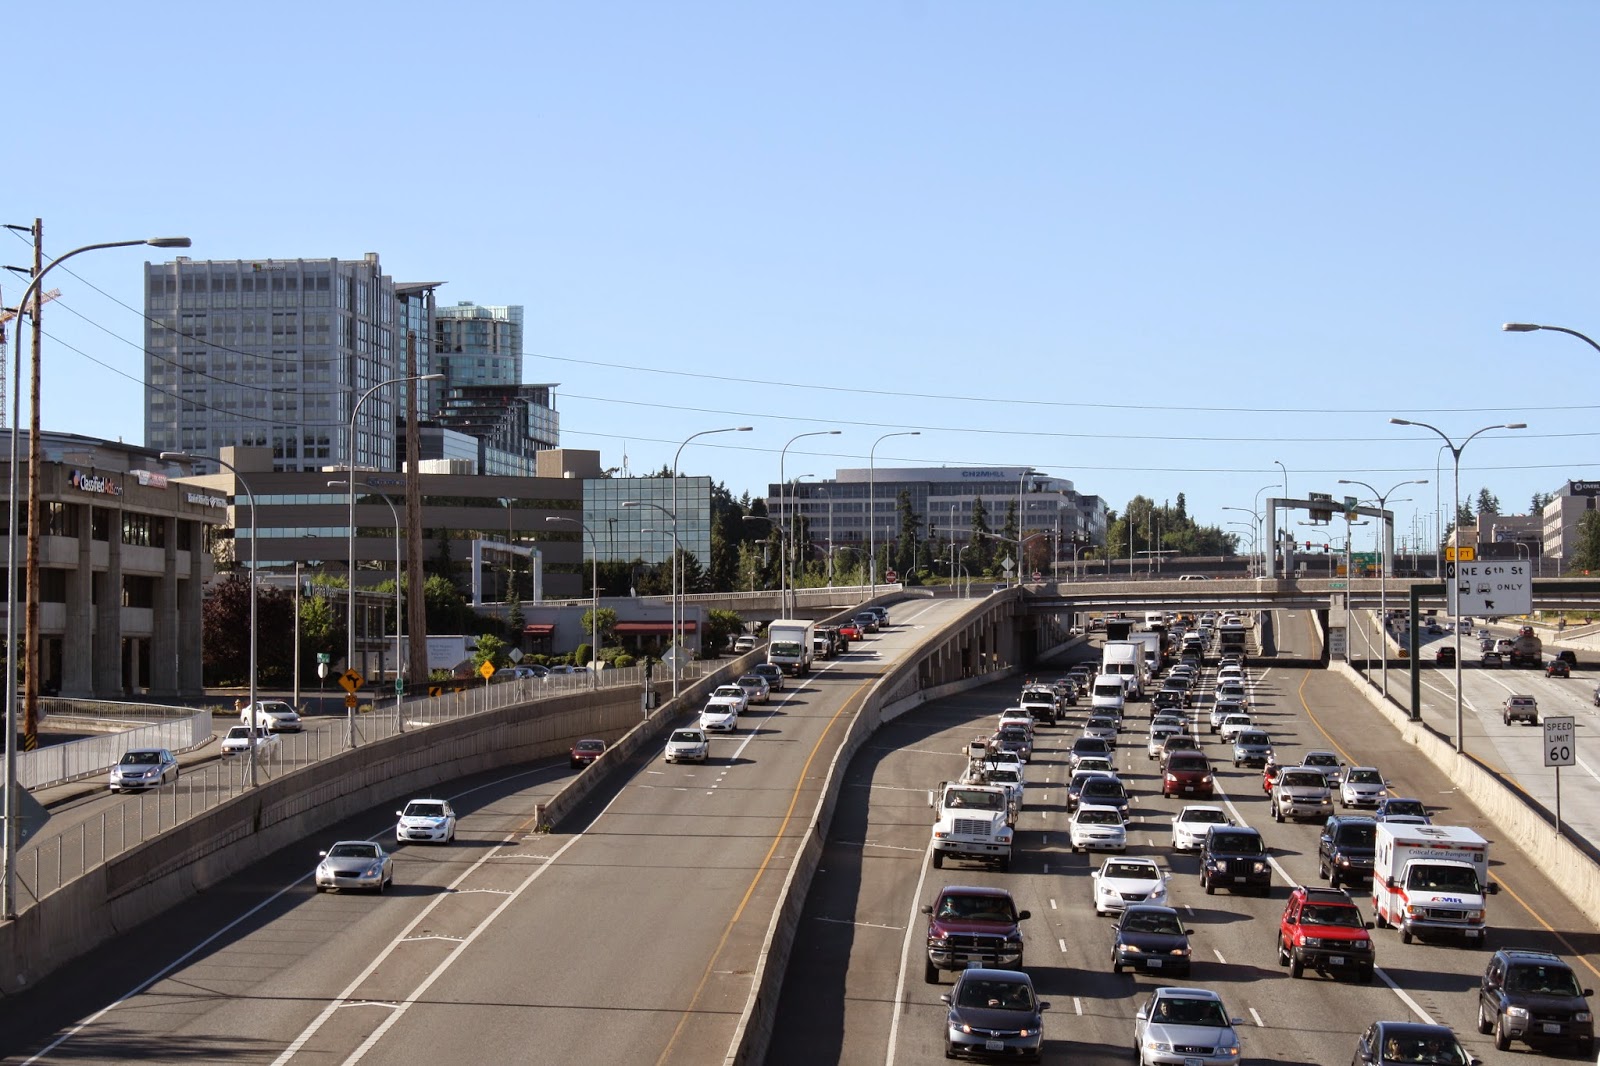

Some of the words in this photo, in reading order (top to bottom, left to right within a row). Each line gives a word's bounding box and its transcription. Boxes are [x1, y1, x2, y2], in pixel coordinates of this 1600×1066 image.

[80, 474, 123, 496] ClassifiedAds.com
[1449, 550, 1471, 558] LFT
[1462, 567, 1478, 576] NE
[1484, 566, 1504, 576] 6th
[1511, 566, 1523, 575] St
[1497, 583, 1523, 591] ONLY
[1546, 722, 1572, 731] SPEED
[1549, 734, 1569, 743] LIMIT
[1550, 746, 1570, 761] 60
